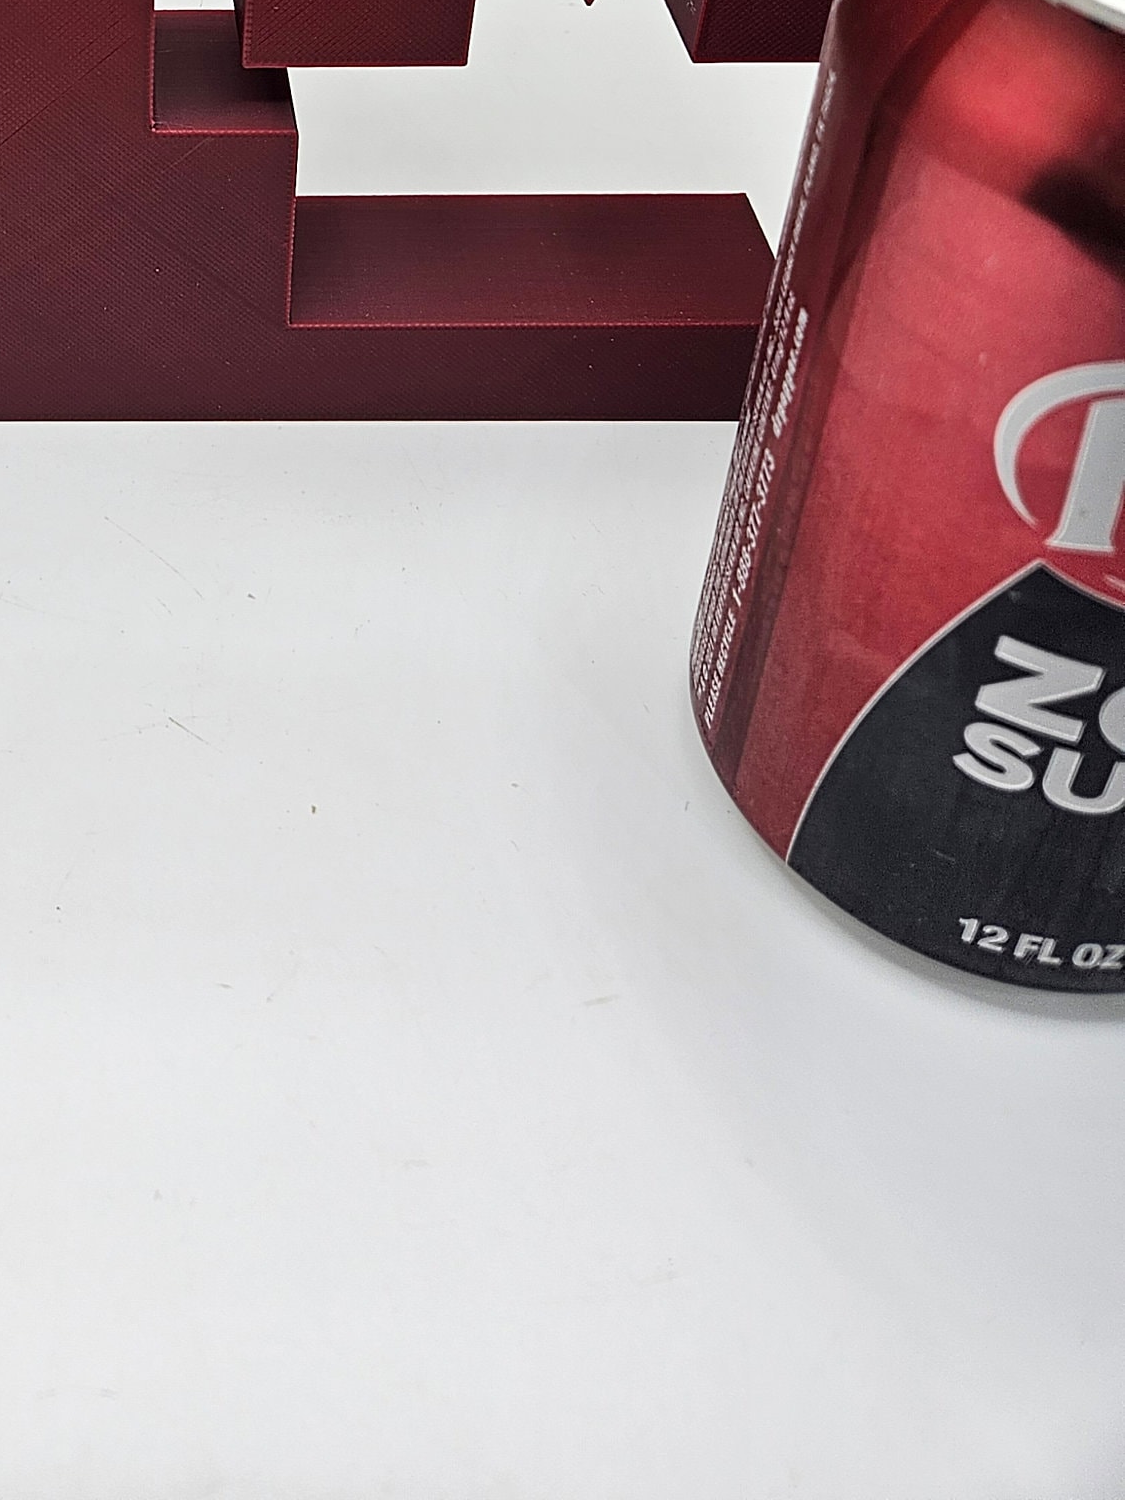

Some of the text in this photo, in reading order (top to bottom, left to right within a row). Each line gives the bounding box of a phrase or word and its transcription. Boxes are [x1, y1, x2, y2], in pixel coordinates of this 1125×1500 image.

[703, 306, 809, 730] PLEASE RECYCLE 1-888-377-3773 drpepper.com
[975, 634, 1125, 754] Z
[958, 917, 1125, 970] 12 FL OZ
